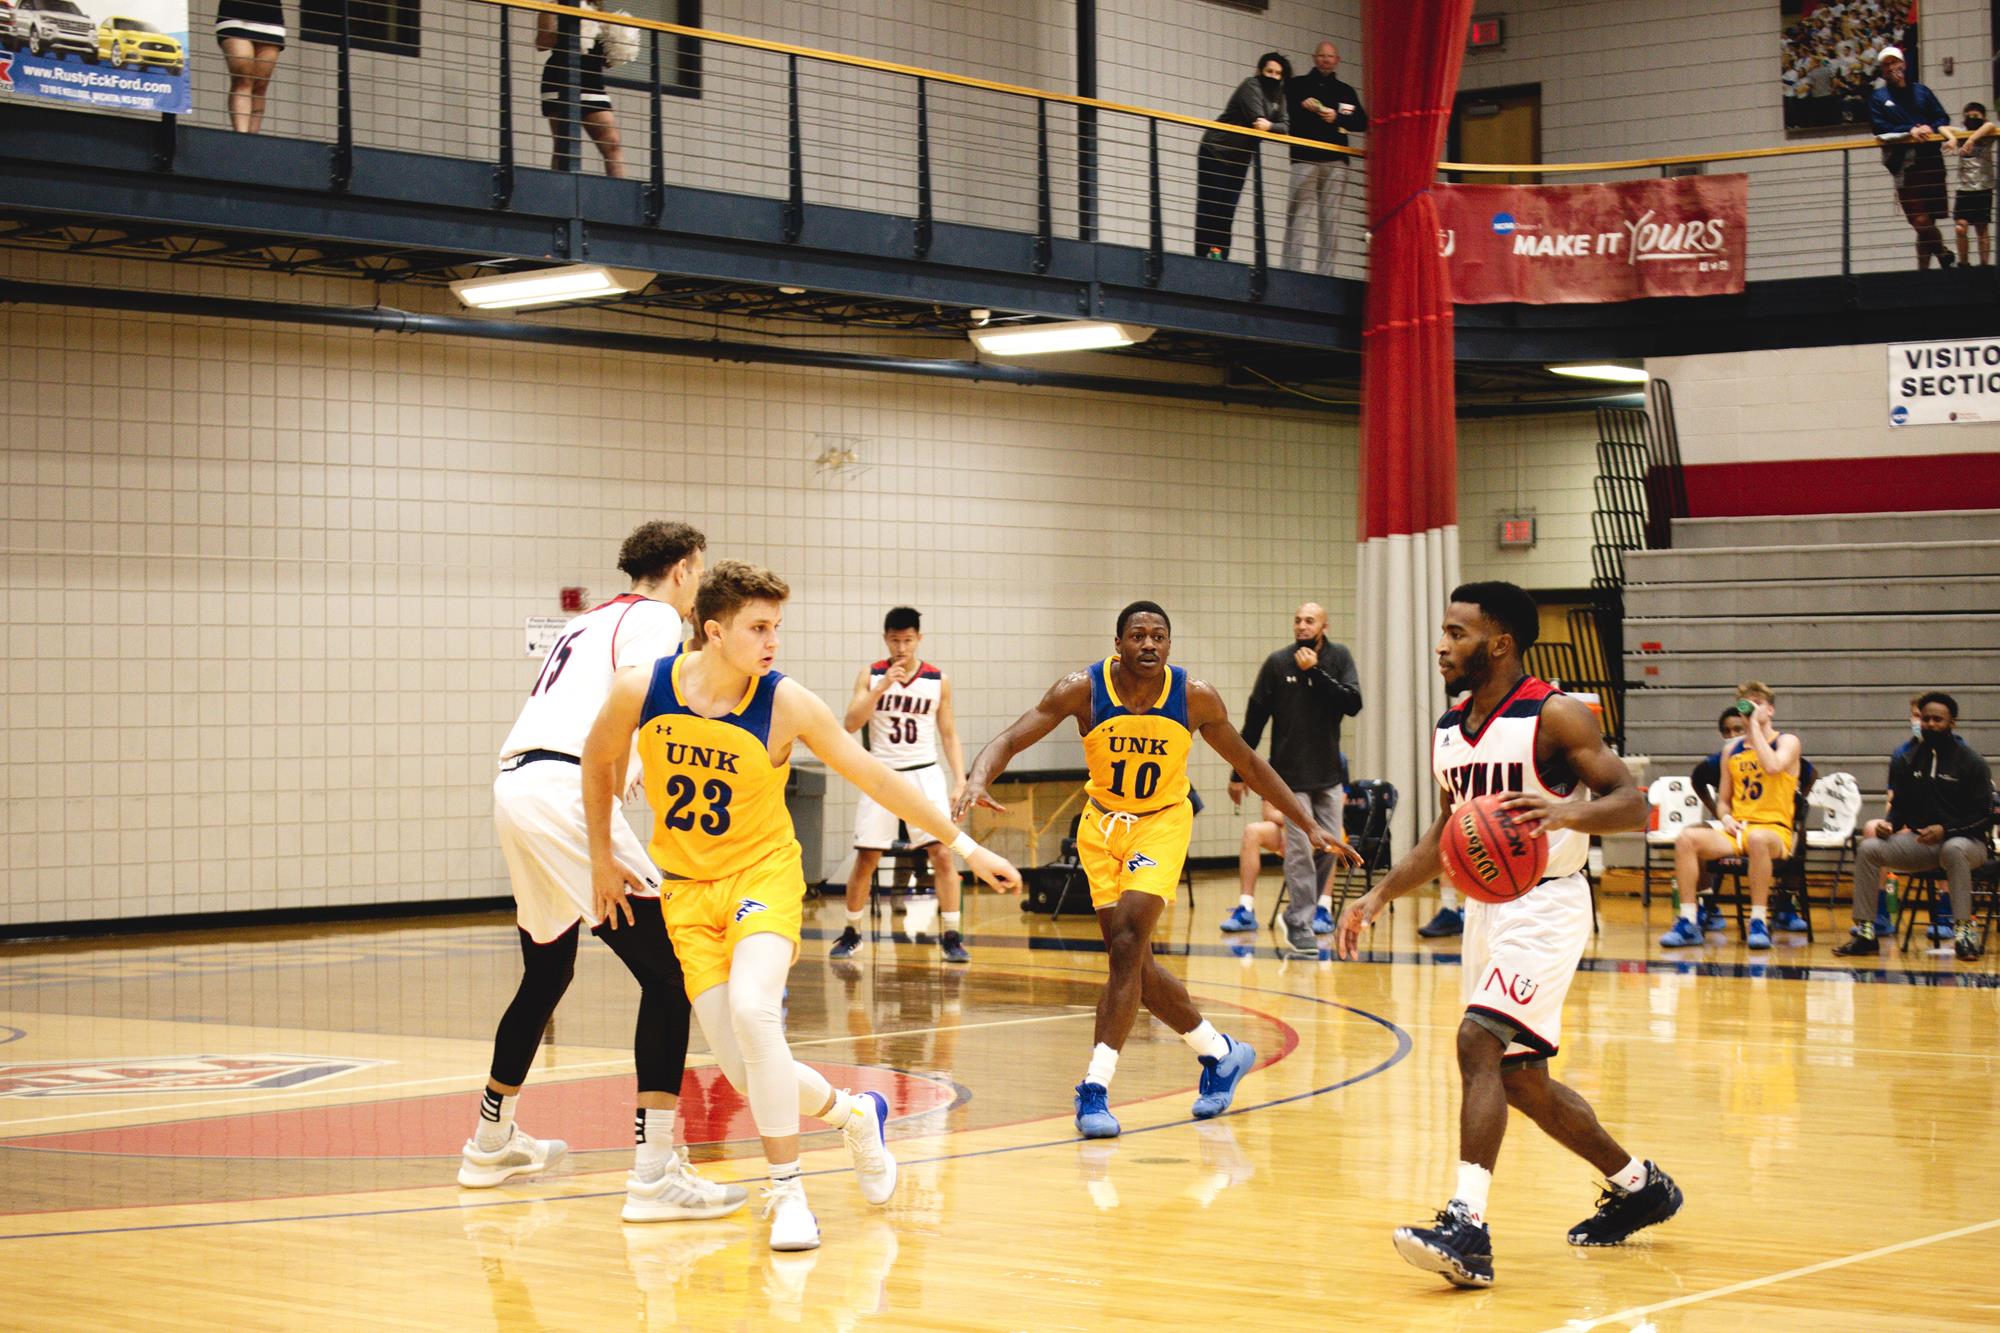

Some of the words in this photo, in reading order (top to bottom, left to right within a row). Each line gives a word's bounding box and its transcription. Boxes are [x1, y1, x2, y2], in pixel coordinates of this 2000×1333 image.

[23, 64, 172, 94] www.RustyEckFord.com
[1513, 234, 1591, 257] MAKE
[1596, 232, 1624, 255] IT
[1624, 209, 1724, 266] YOURS
[1905, 345, 2000, 369] VISITO
[530, 627, 589, 697] 15
[888, 715, 918, 745] 30
[1109, 736, 1169, 756] UNK
[665, 741, 740, 775] UNK
[1106, 759, 1162, 800] 10
[664, 774, 733, 836] 23
